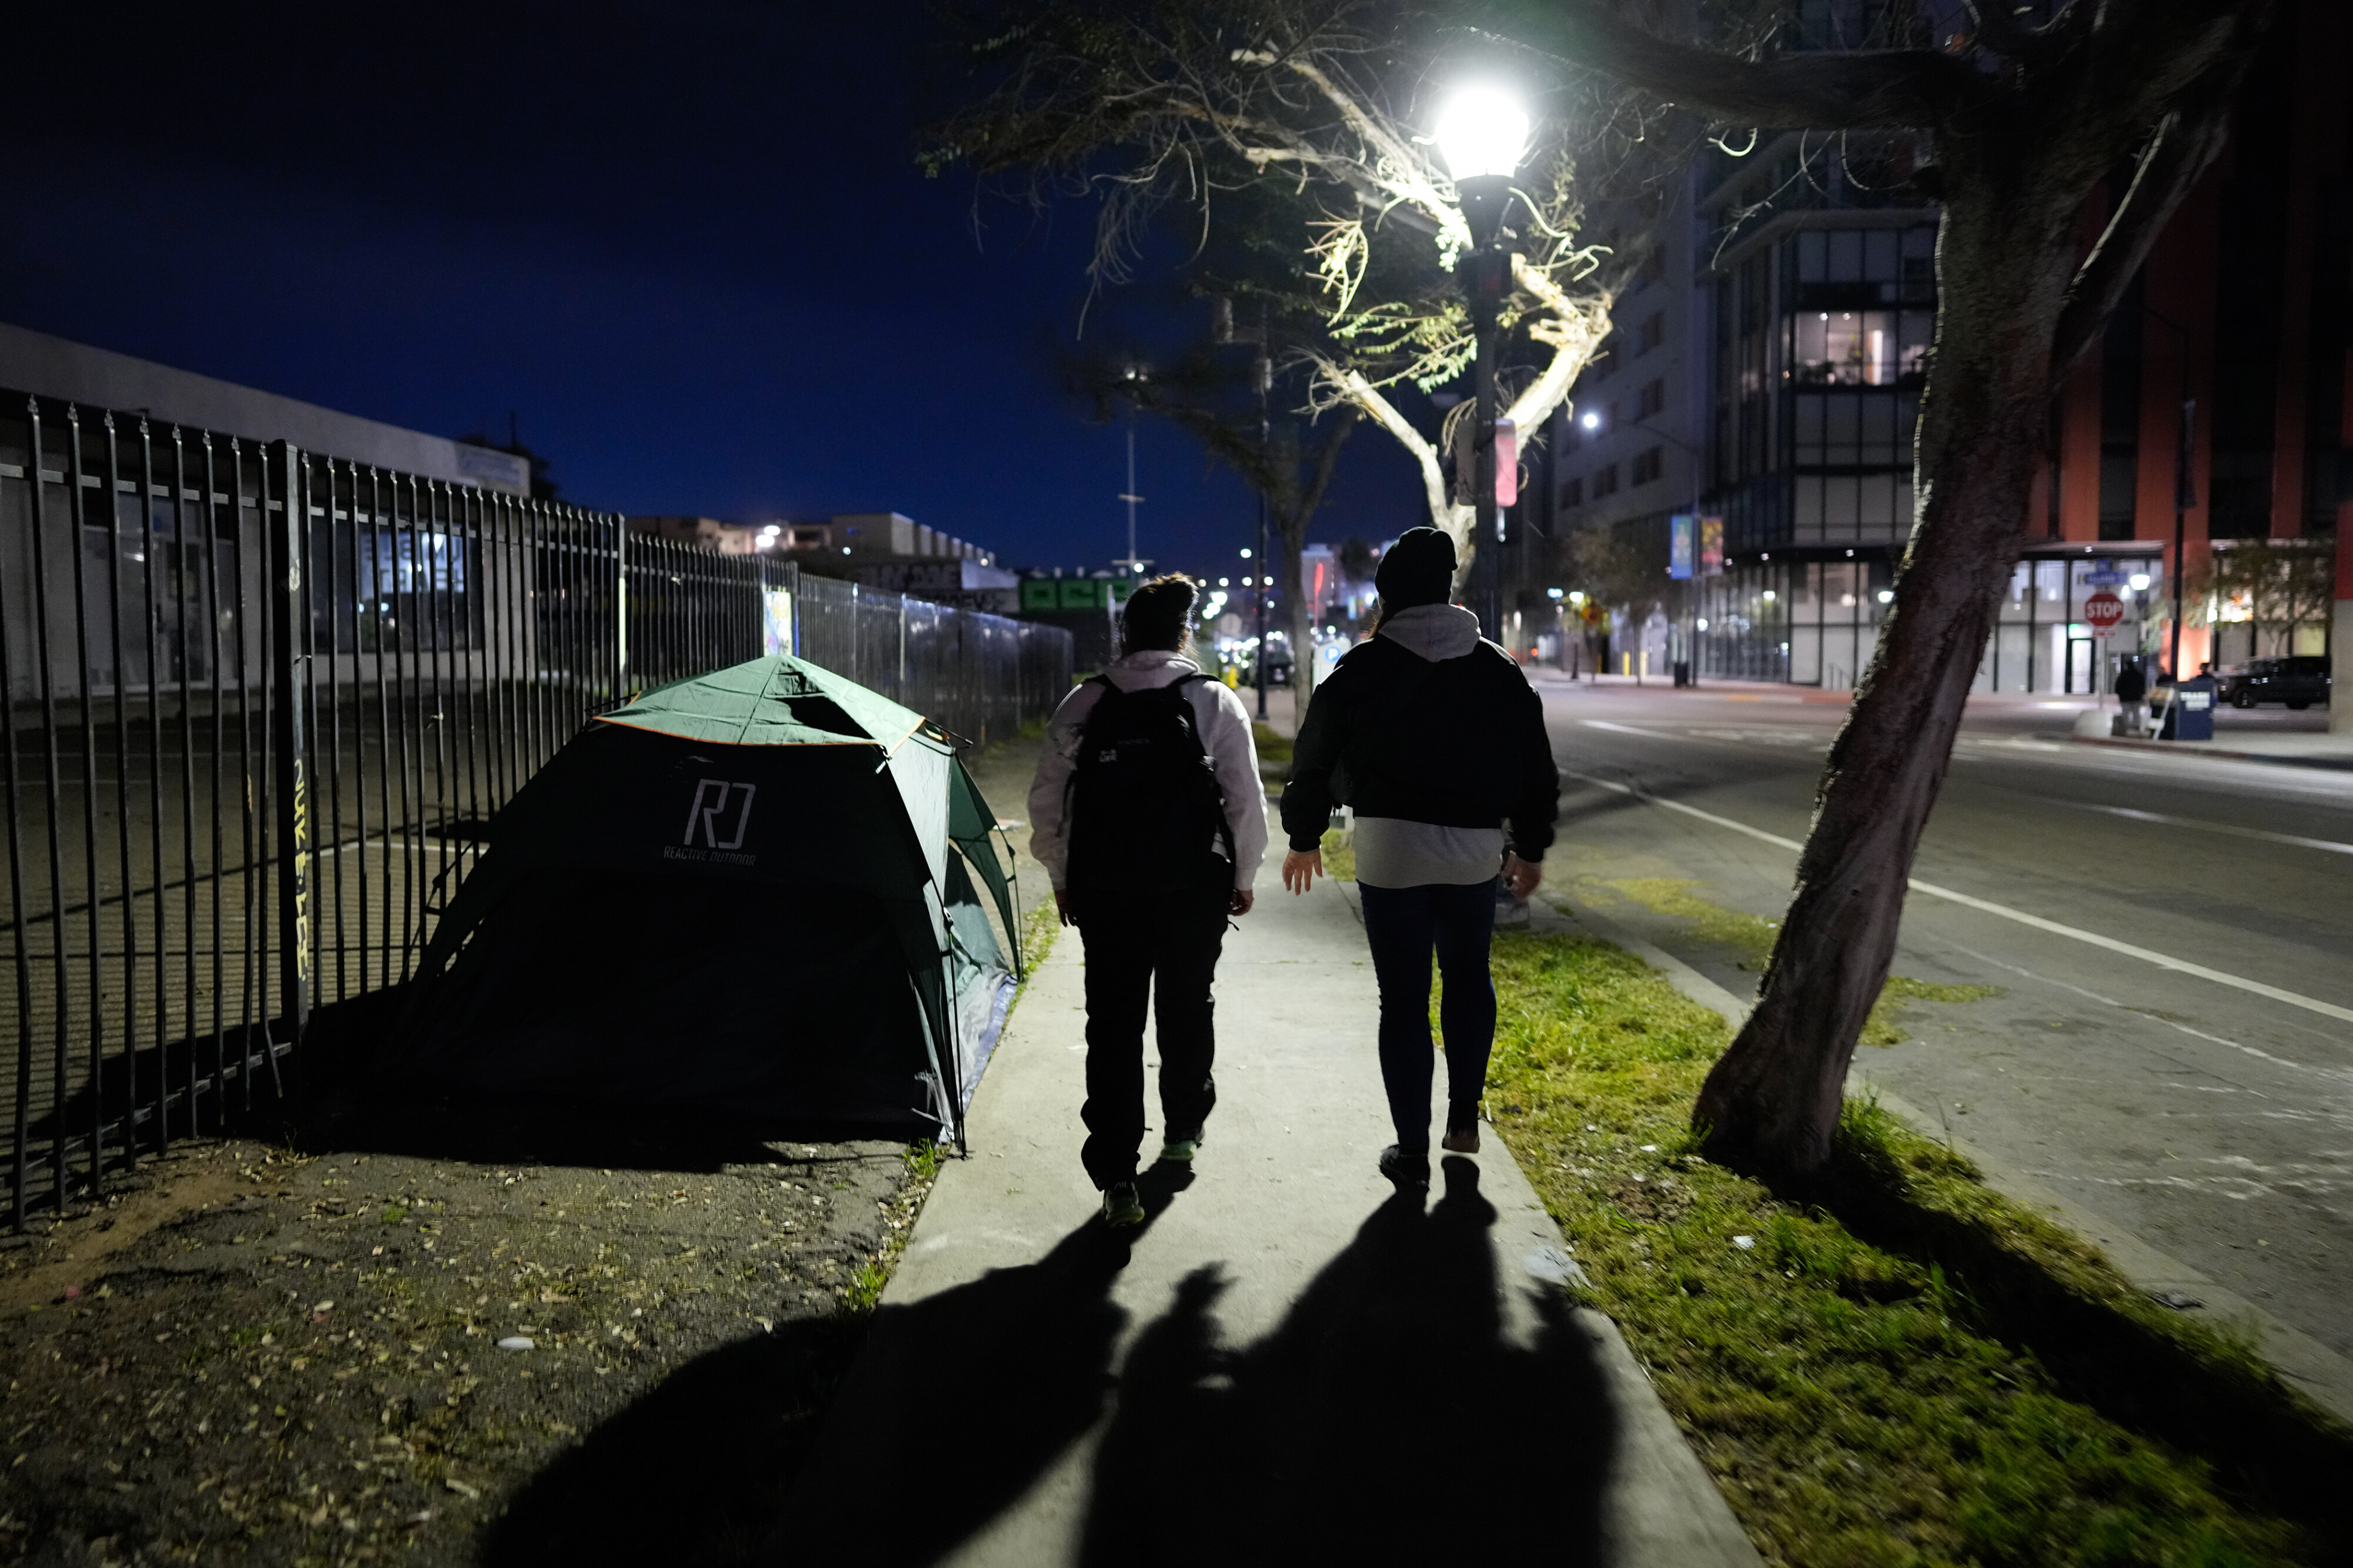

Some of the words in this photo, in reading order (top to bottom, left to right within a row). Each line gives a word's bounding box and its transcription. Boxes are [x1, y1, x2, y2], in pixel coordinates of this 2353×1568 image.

[2087, 602, 2122, 619] STOP
[664, 845, 708, 861] REACTIVE
[709, 851, 756, 867] OUTDOOR
